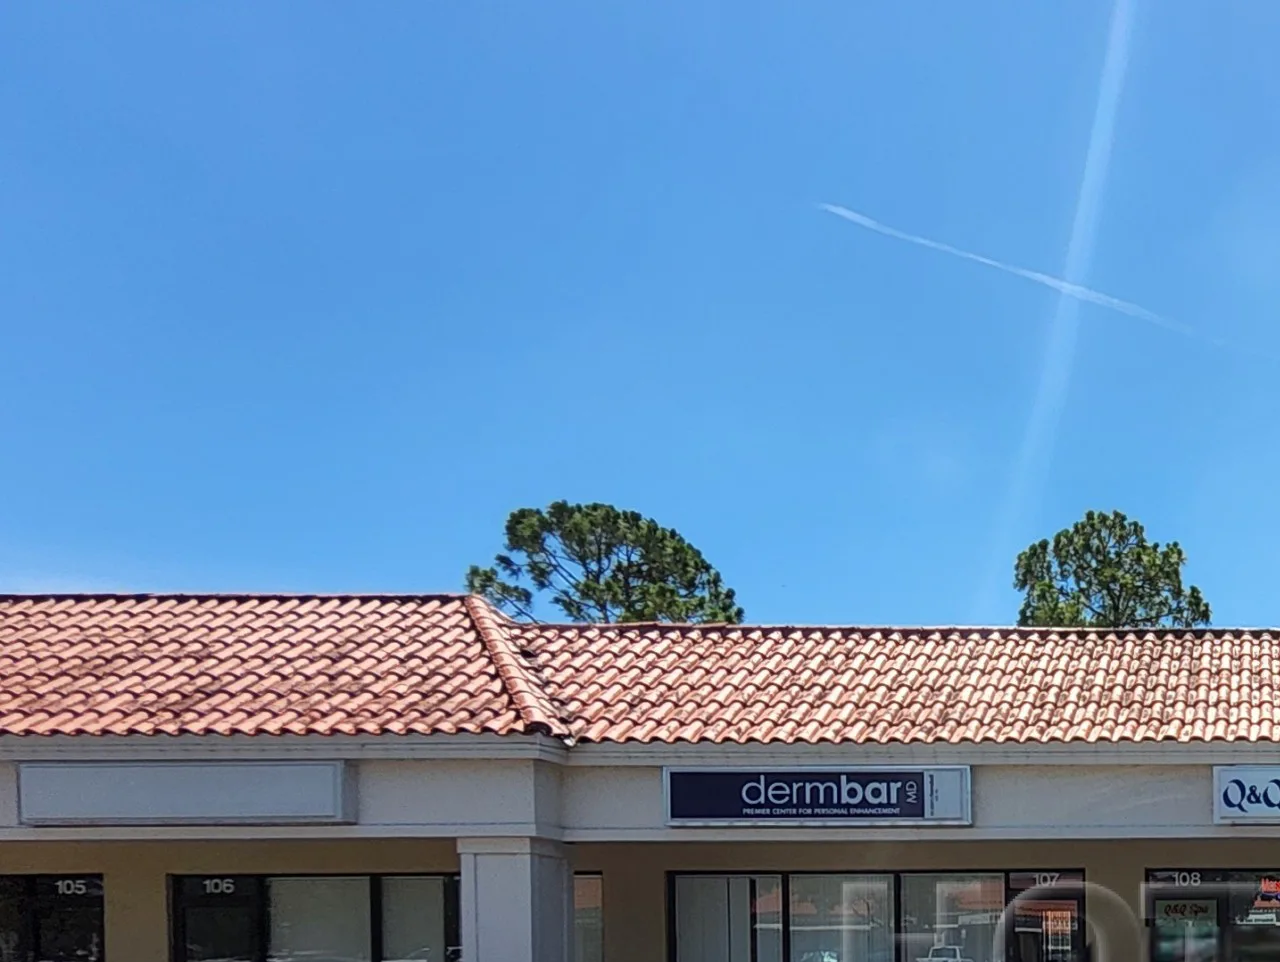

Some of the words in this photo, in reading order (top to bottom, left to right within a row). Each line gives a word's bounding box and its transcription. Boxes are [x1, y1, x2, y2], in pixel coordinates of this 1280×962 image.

[741, 775, 903, 805] dermbar
[906, 780, 918, 804] MD
[743, 807, 770, 815] PREMIER
[772, 807, 797, 815] CENTER
[798, 807, 812, 815] FOR
[814, 807, 848, 815] PERSONAL
[850, 807, 901, 815] ENHANCEMENT
[203, 879, 235, 894] 106
[1033, 873, 1060, 887] 107
[1172, 872, 1201, 887] 108
[55, 880, 87, 895] 105
[1164, 904, 1187, 917] Q&Q
